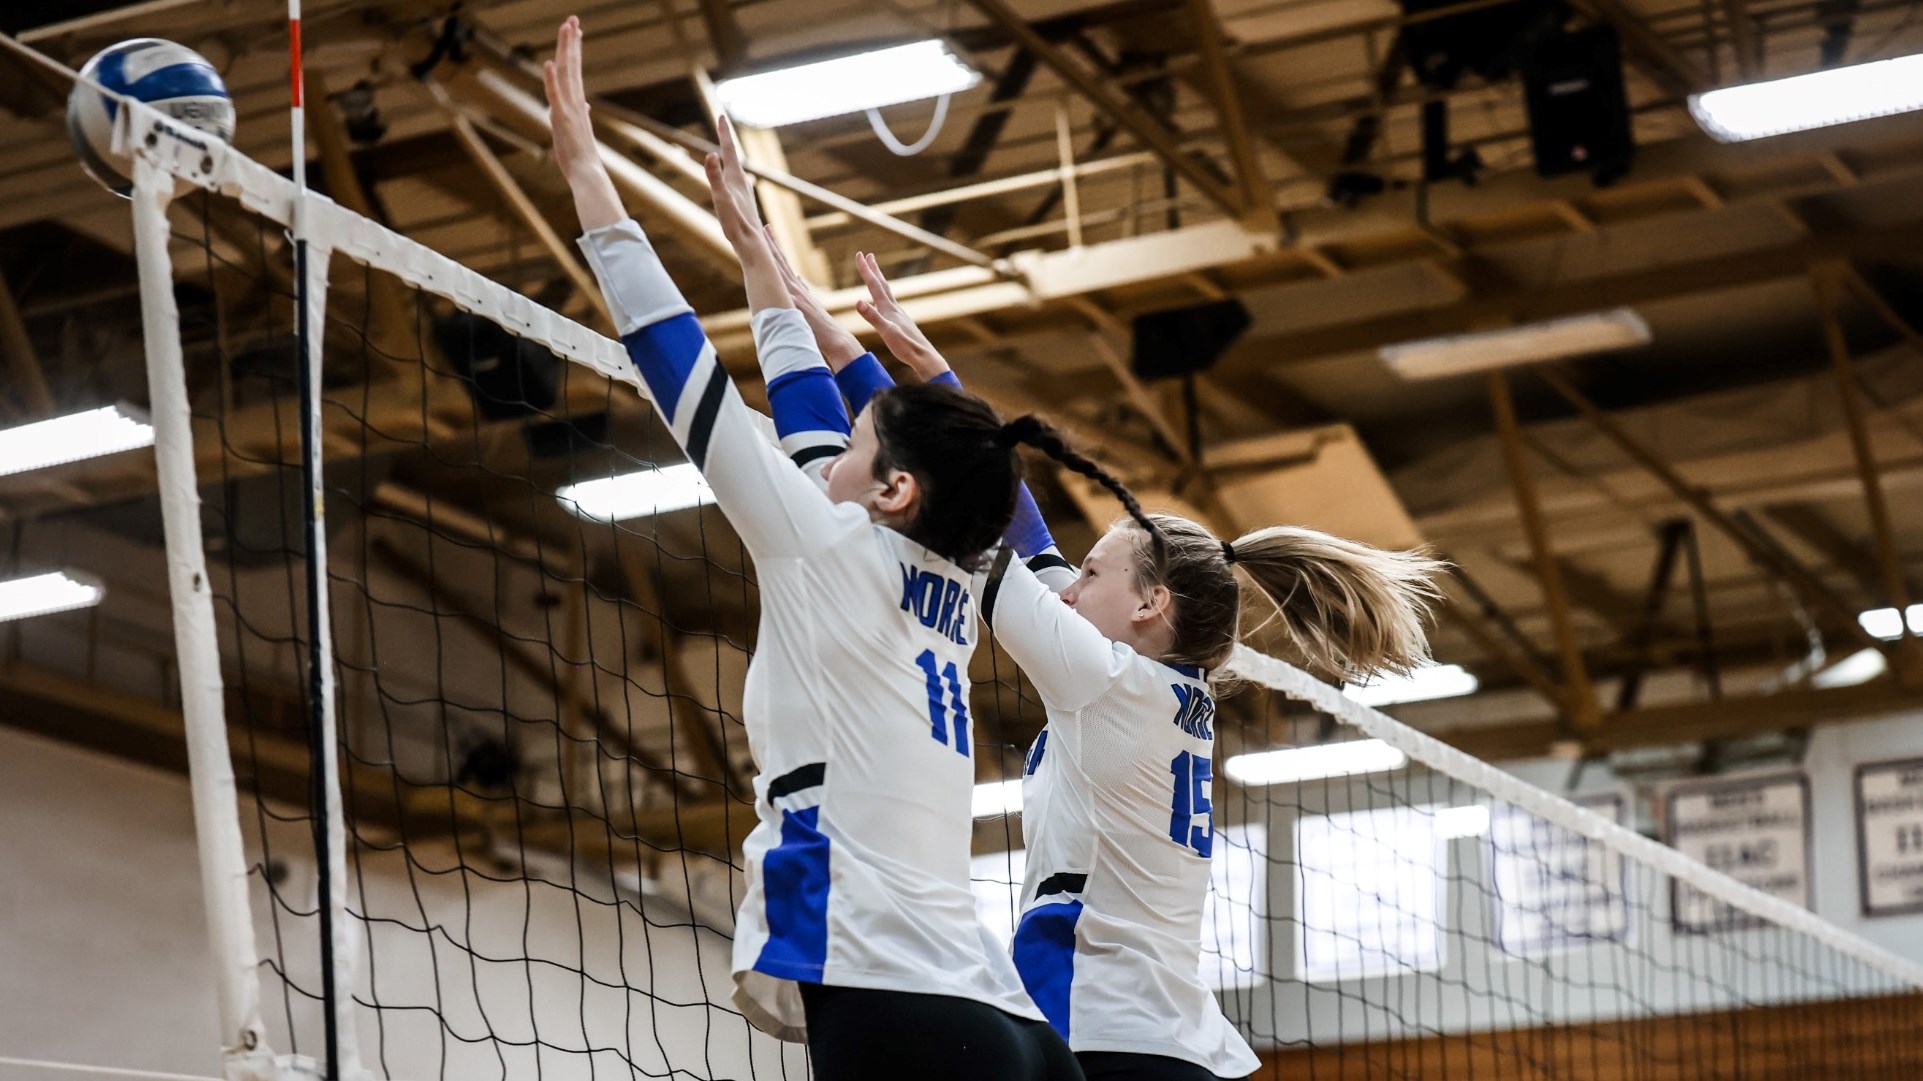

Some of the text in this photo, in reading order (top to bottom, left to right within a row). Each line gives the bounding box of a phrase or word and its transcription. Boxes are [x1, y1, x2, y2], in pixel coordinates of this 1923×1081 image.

[900, 561, 969, 646] NORE
[915, 648, 970, 758] 11
[1169, 749, 1214, 859] 15
